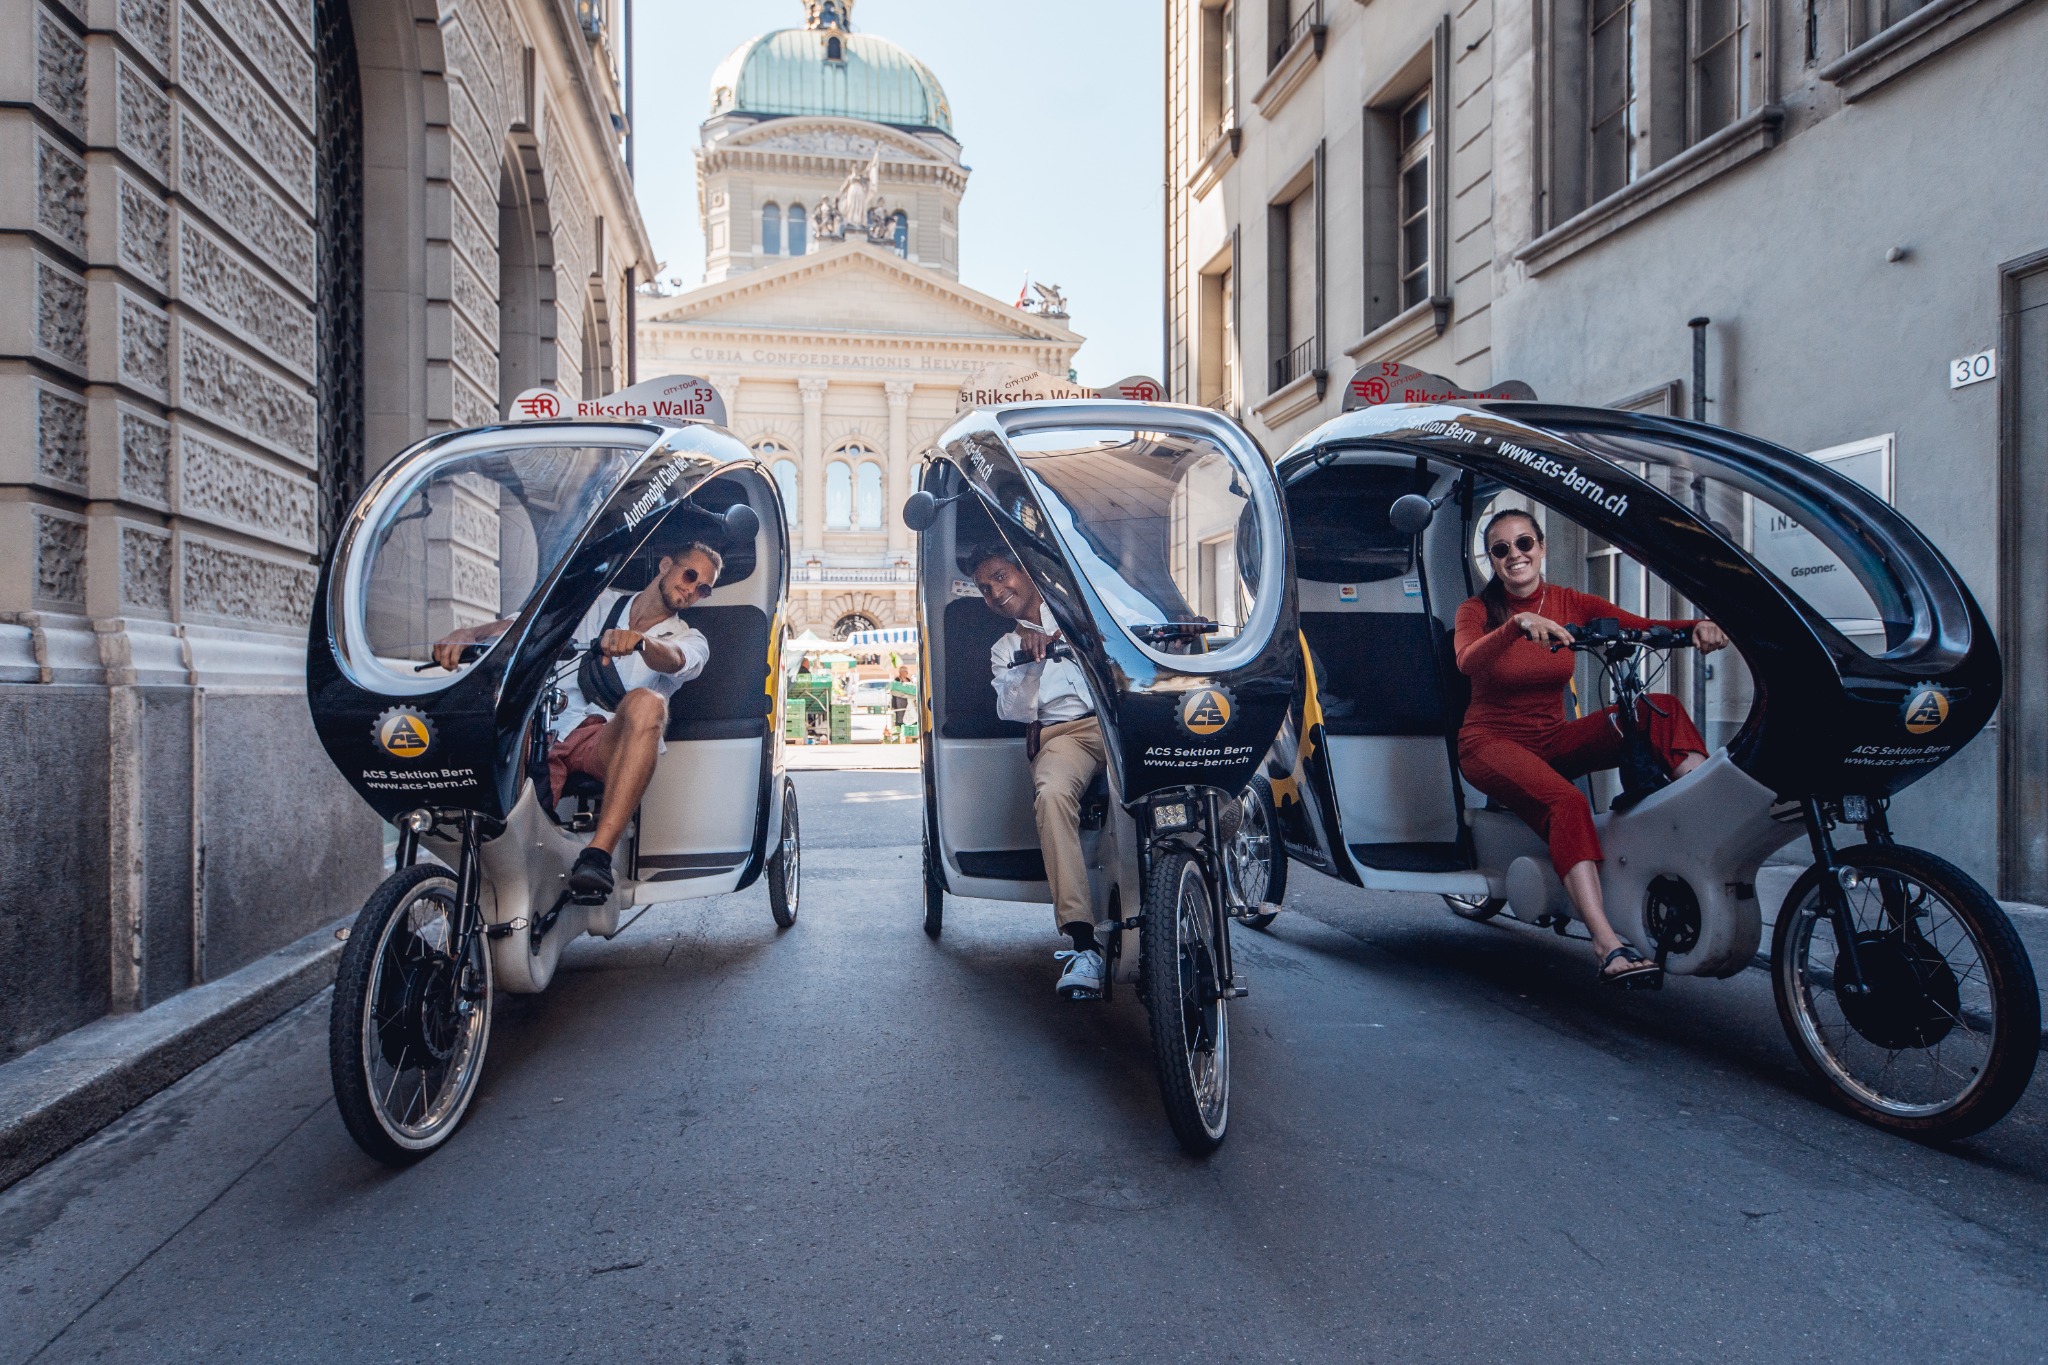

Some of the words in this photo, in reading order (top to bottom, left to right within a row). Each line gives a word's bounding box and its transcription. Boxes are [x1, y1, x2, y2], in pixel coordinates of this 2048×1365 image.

[690, 347, 743, 361] CURIA
[752, 349, 911, 368] CONFOEDERATIONIS
[921, 356, 1014, 371] HELVETI
[1381, 362, 1399, 377] 52
[1956, 355, 1990, 383] 30
[1005, 371, 1039, 389] CITY-TOUR
[1390, 371, 1422, 387] CITY-TOUR
[663, 379, 698, 396] CITY-TOUR
[694, 388, 713, 402] 53
[961, 391, 973, 403] 51
[976, 389, 1044, 405] Rikscha
[577, 400, 647, 416] Rikscha
[653, 399, 705, 416] Walla
[1404, 415, 1447, 434] Sektion
[1444, 421, 1478, 443] Bern
[1497, 440, 1630, 517] www.acs-bern.ch
[623, 476, 667, 532] Automobil
[659, 462, 680, 486] Club
[673, 456, 690, 472] der
[1791, 564, 1837, 577] Gsponer.
[1145, 747, 1171, 756] ACS
[1174, 747, 1220, 757] Sektion
[1224, 746, 1253, 755] Bern
[1852, 745, 1879, 755] ACS
[1879, 746, 1923, 755] Sektion
[1924, 745, 1951, 754] Bern
[1143, 756, 1249, 767] www.acs-bern.ch
[1843, 756, 1940, 766] www.acs-bern.ch
[362, 770, 388, 779] ACS
[390, 770, 438, 779] Sektion
[441, 768, 474, 778] Bern
[366, 778, 478, 790] www.acs-bern.ch
